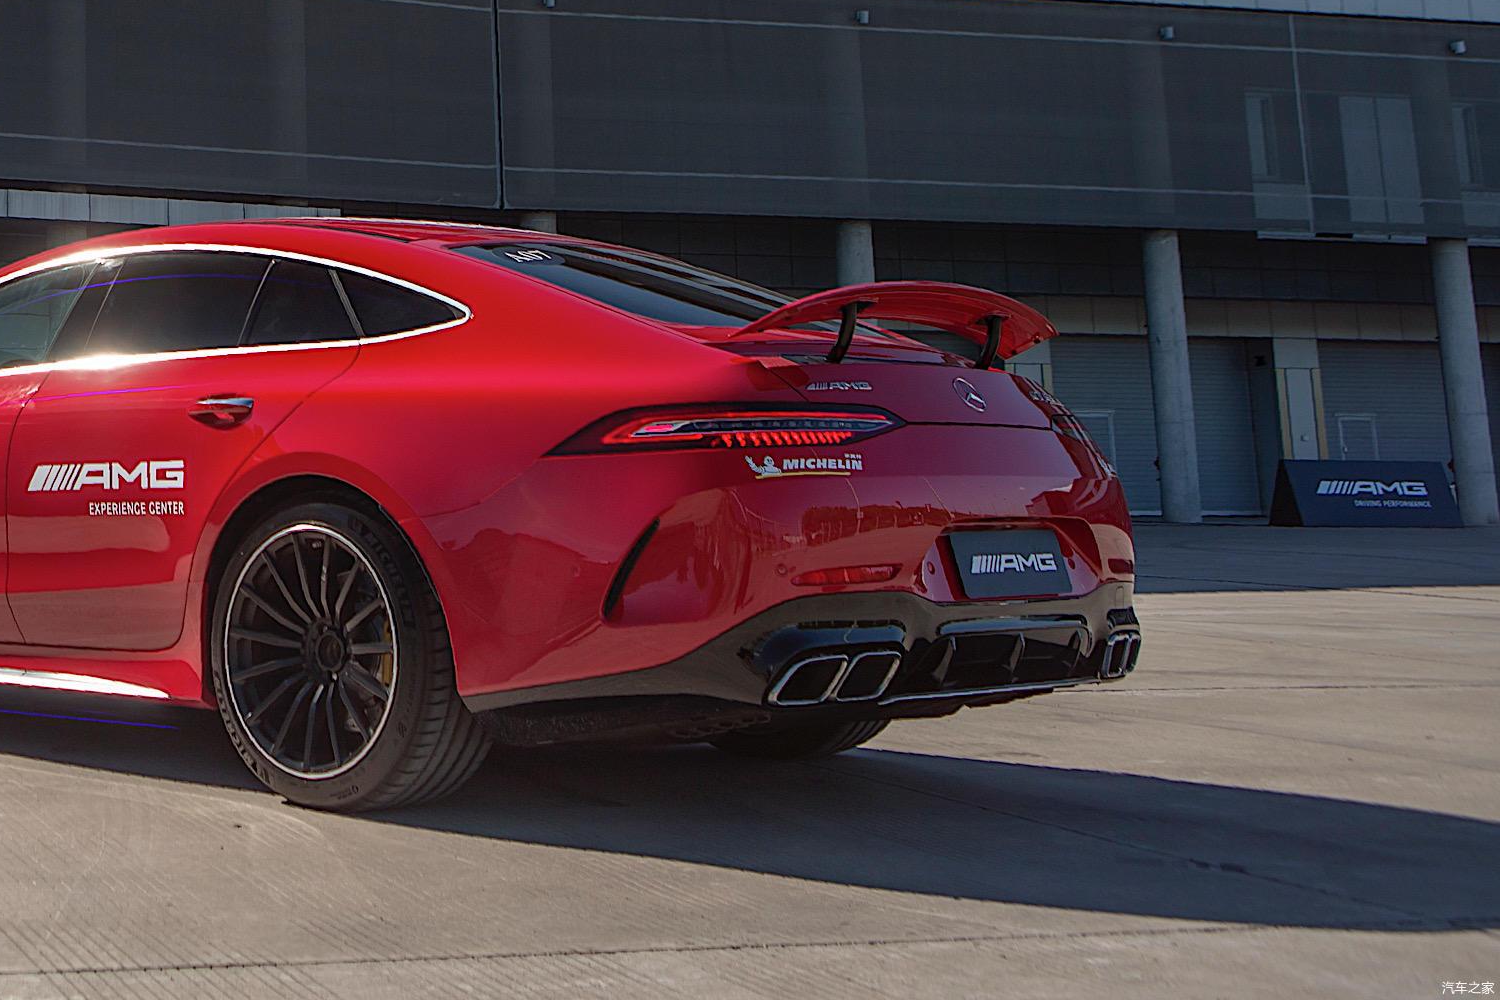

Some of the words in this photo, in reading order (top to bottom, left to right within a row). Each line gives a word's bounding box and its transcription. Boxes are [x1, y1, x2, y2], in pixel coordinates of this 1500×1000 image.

[782, 457, 863, 471] MICHELIN
[73, 460, 185, 491] AMG
[1351, 481, 1429, 495] AMG
[88, 501, 147, 516] EXPERIENCE
[148, 500, 185, 515] CENTER
[1000, 553, 1058, 573] AMG
